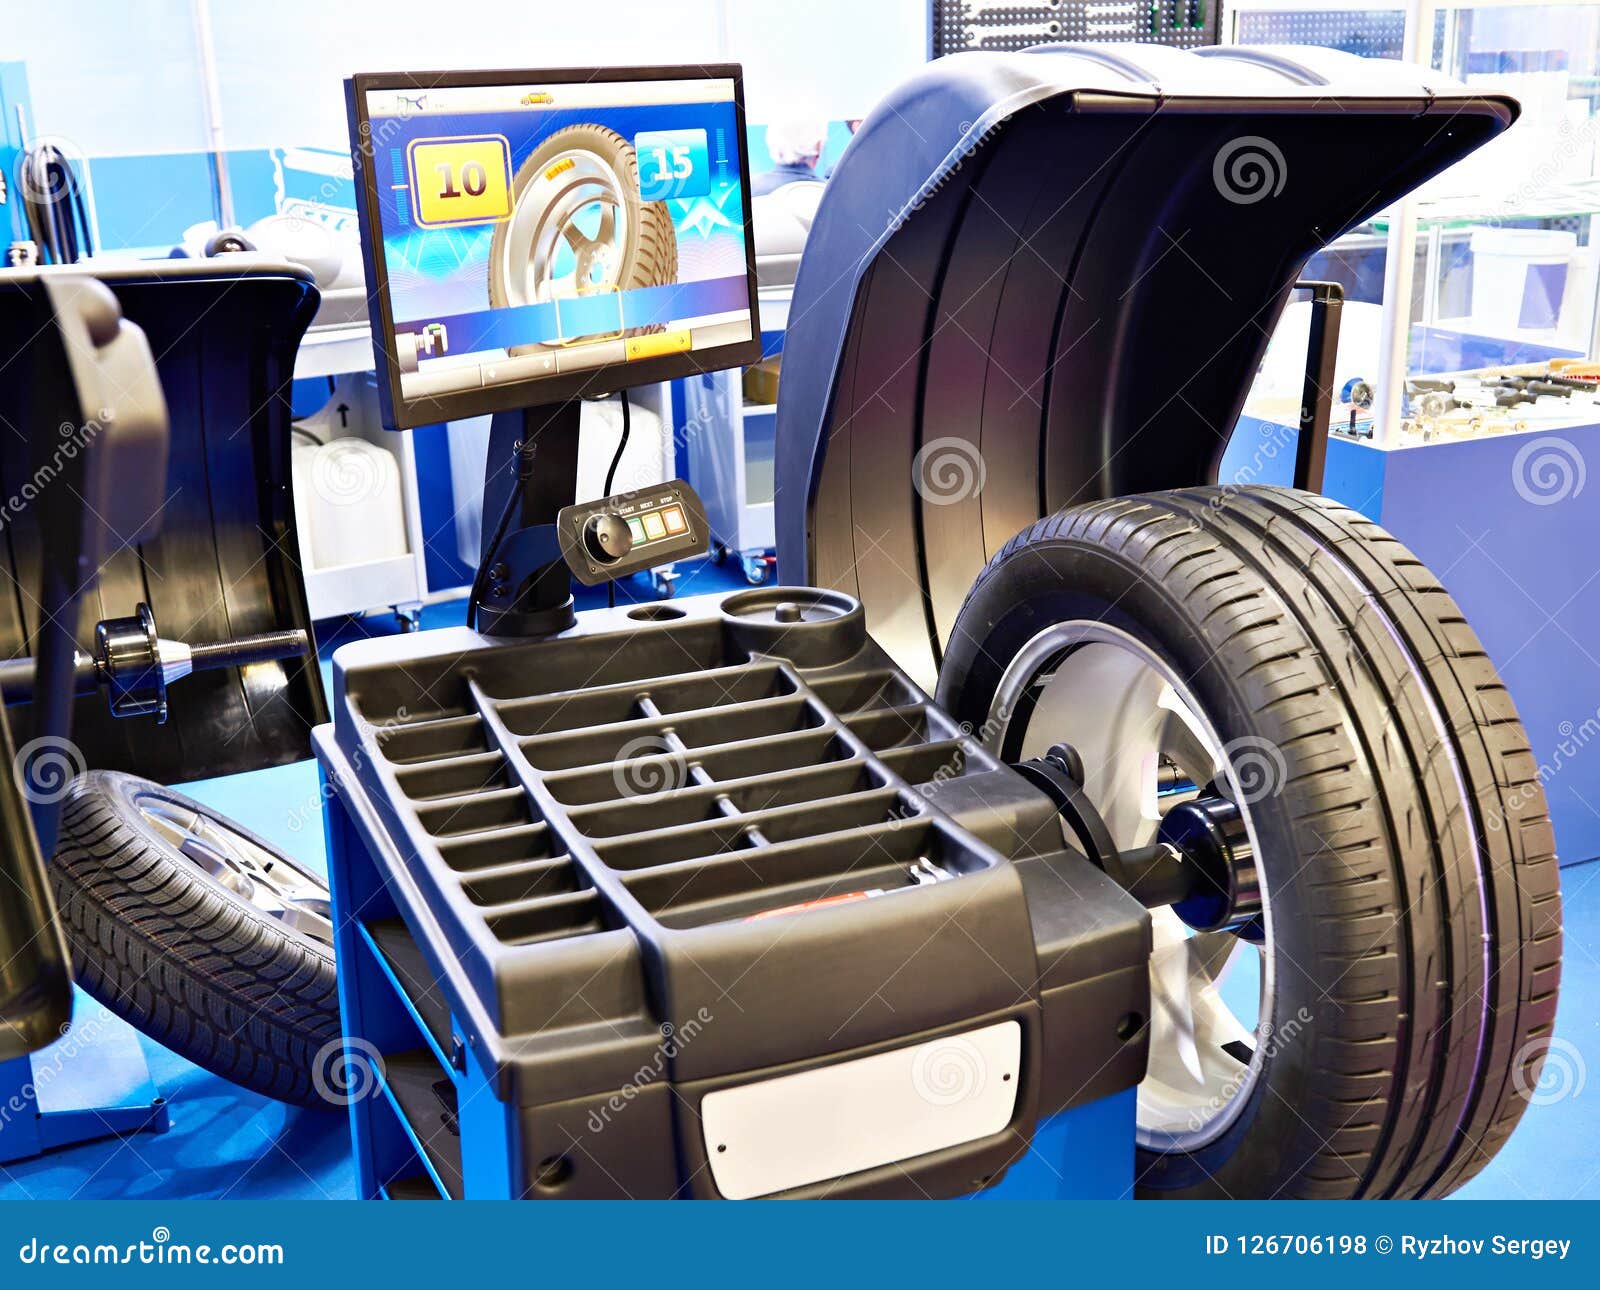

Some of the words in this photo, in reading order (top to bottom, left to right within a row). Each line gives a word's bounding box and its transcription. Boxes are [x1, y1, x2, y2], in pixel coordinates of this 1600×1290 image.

[434, 160, 487, 199] 10
[651, 146, 694, 181] 15
[639, 501, 654, 510] NEXT
[660, 496, 673, 504] STOP
